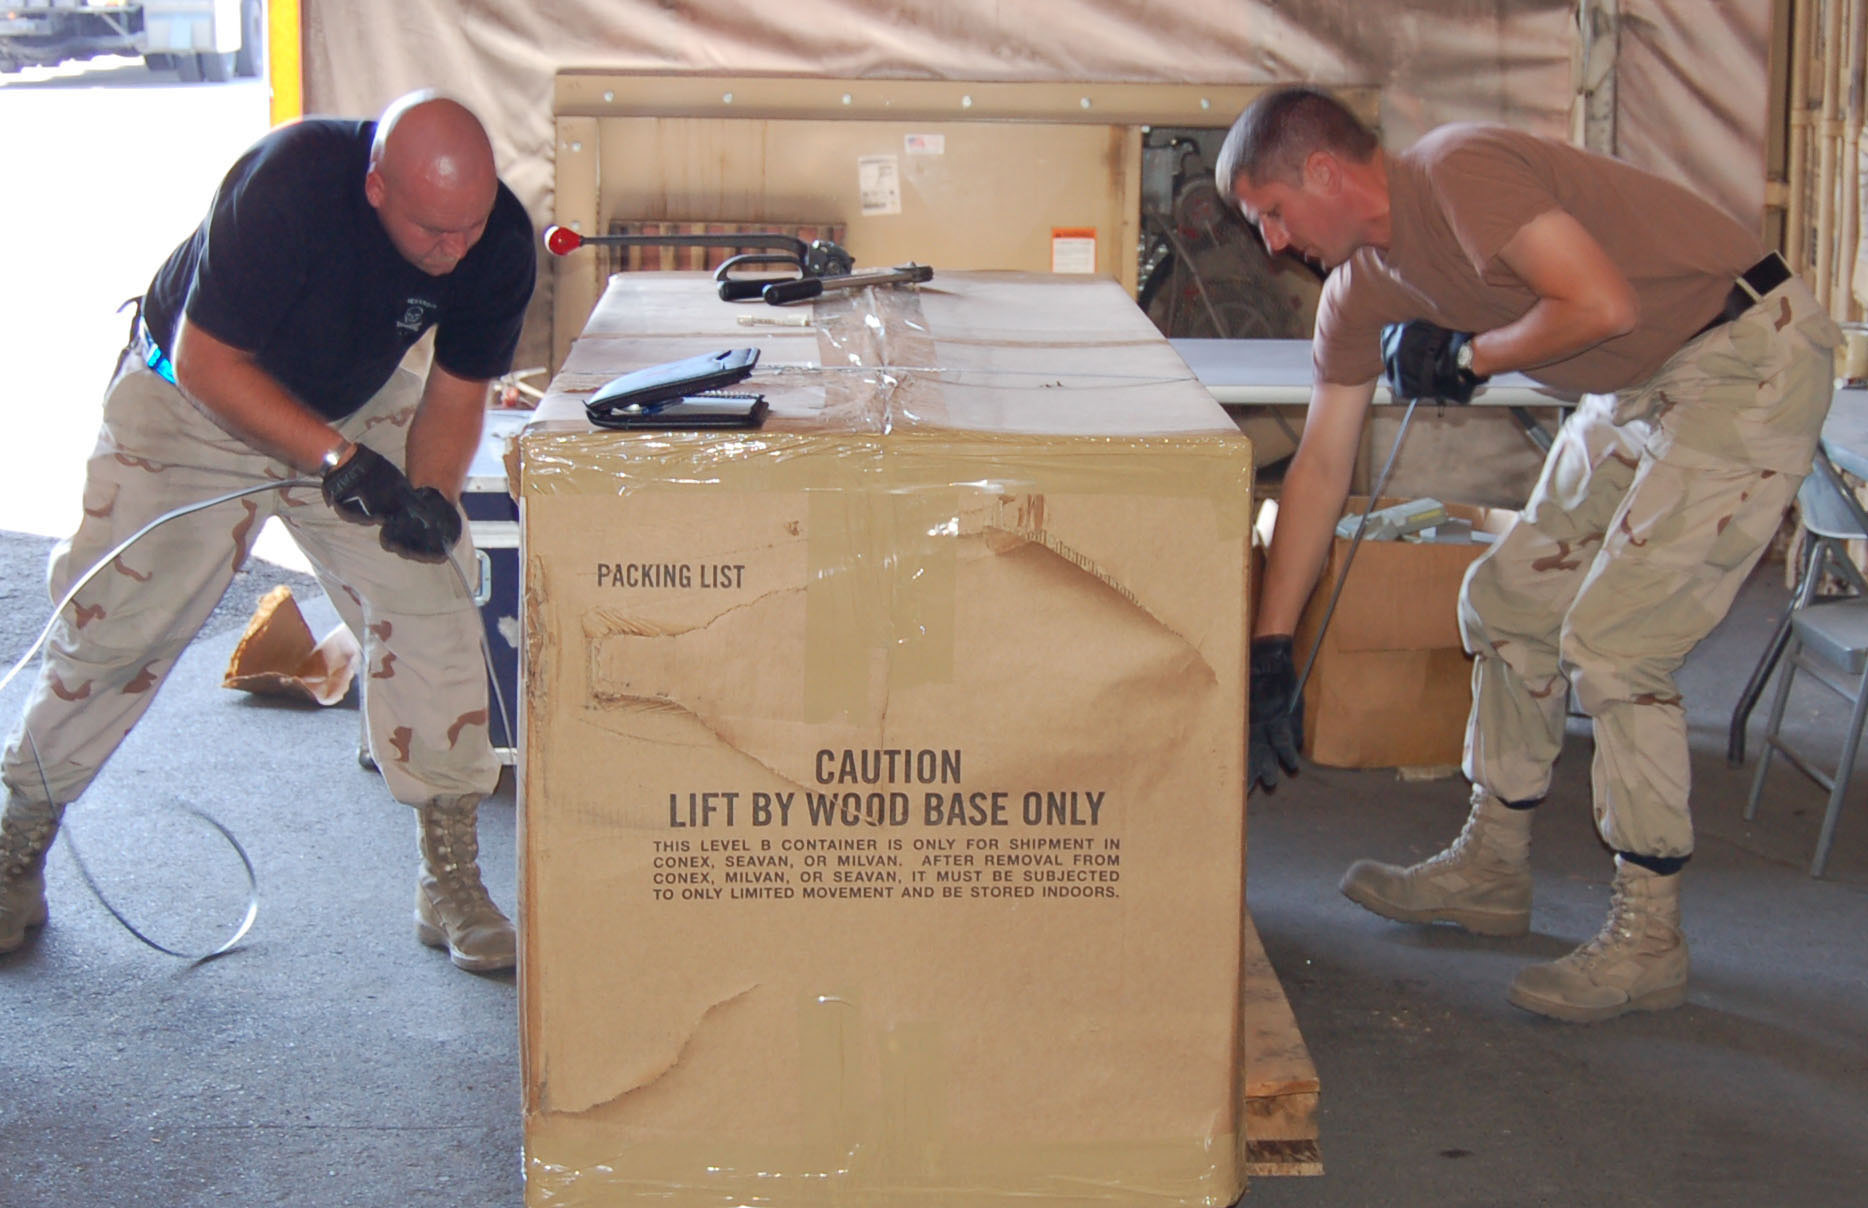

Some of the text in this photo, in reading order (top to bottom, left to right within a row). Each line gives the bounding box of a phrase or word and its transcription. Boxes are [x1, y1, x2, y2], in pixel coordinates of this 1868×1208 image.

[597, 562, 746, 589] PACKING LIST
[815, 748, 962, 785] CAUTION
[669, 791, 1106, 828] LIFT BY WOOD BASE ONLY
[652, 837, 1121, 853] THIS LEVEL B CONTAINER IS ONLY FOR SHIPMENT IN
[653, 854, 1120, 869] CONEX, SEAVAN, OR MILVAN. AFTER REMOVAL FROM
[652, 870, 1120, 886] CONEX, MILVAN, OR SEAVAN, IT MUST BE SUBJECTED
[652, 885, 1120, 901] TO ONLY LIMITED MOVEMENT AND BE STORED INDOORS.
